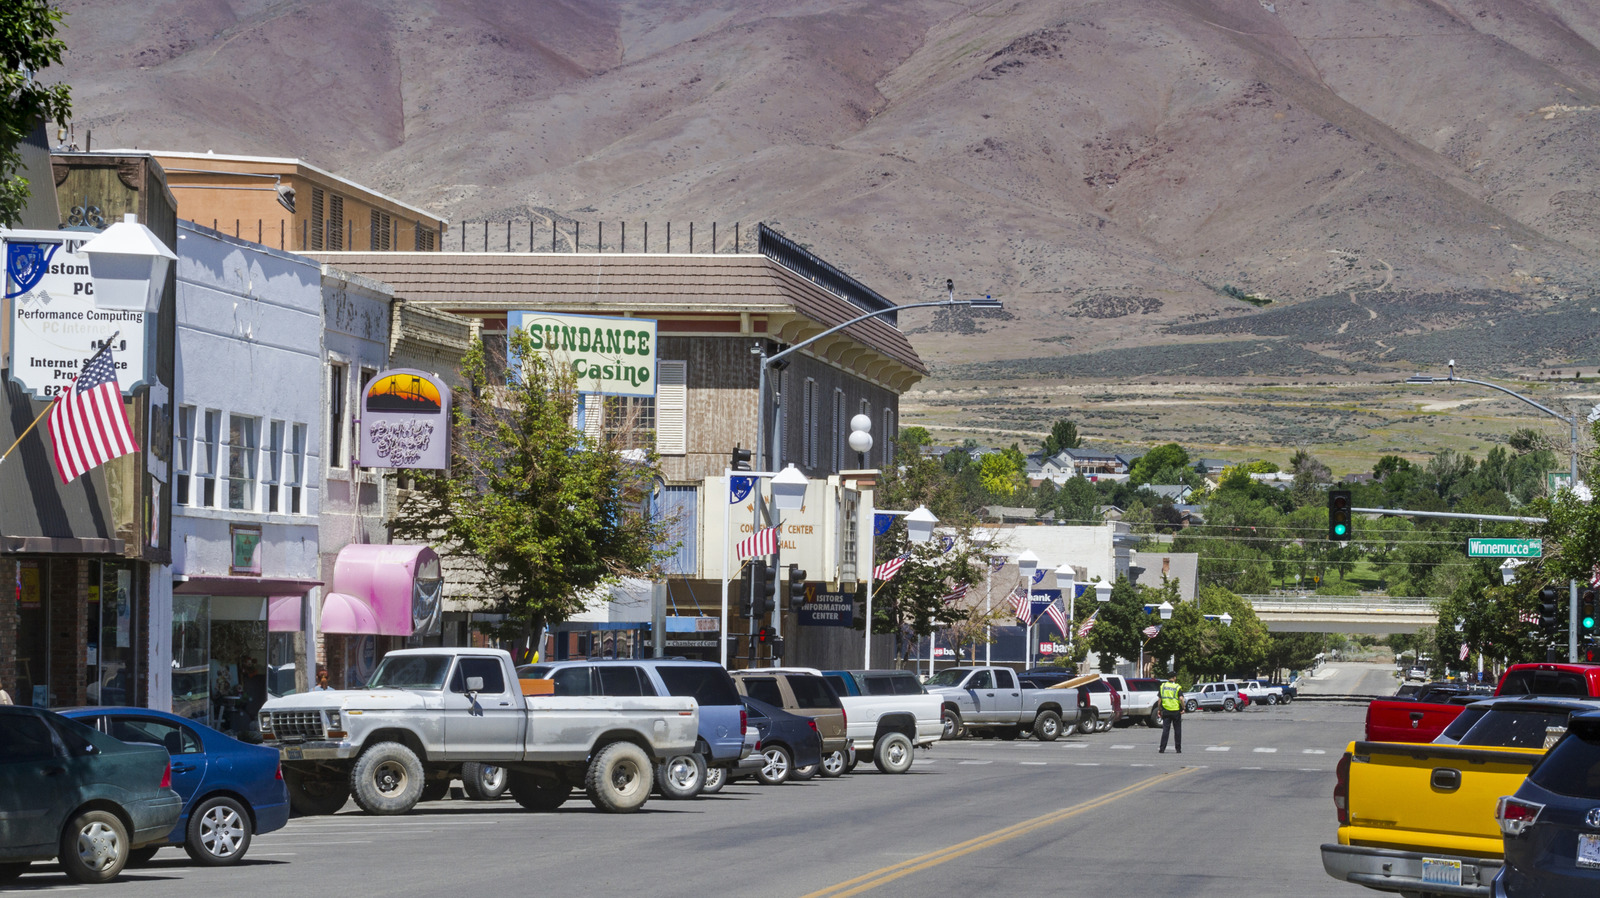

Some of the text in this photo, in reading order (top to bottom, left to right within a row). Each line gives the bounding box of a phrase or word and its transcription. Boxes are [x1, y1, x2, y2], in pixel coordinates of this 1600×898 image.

[17, 309, 143, 323] Performance Computing
[530, 323, 650, 356] SUNDANCE
[30, 357, 78, 368] Internet
[572, 358, 650, 388] Casino
[788, 525, 813, 534] CENTER
[1470, 541, 1529, 554] Winnemucca
[812, 612, 839, 620] CENTER
